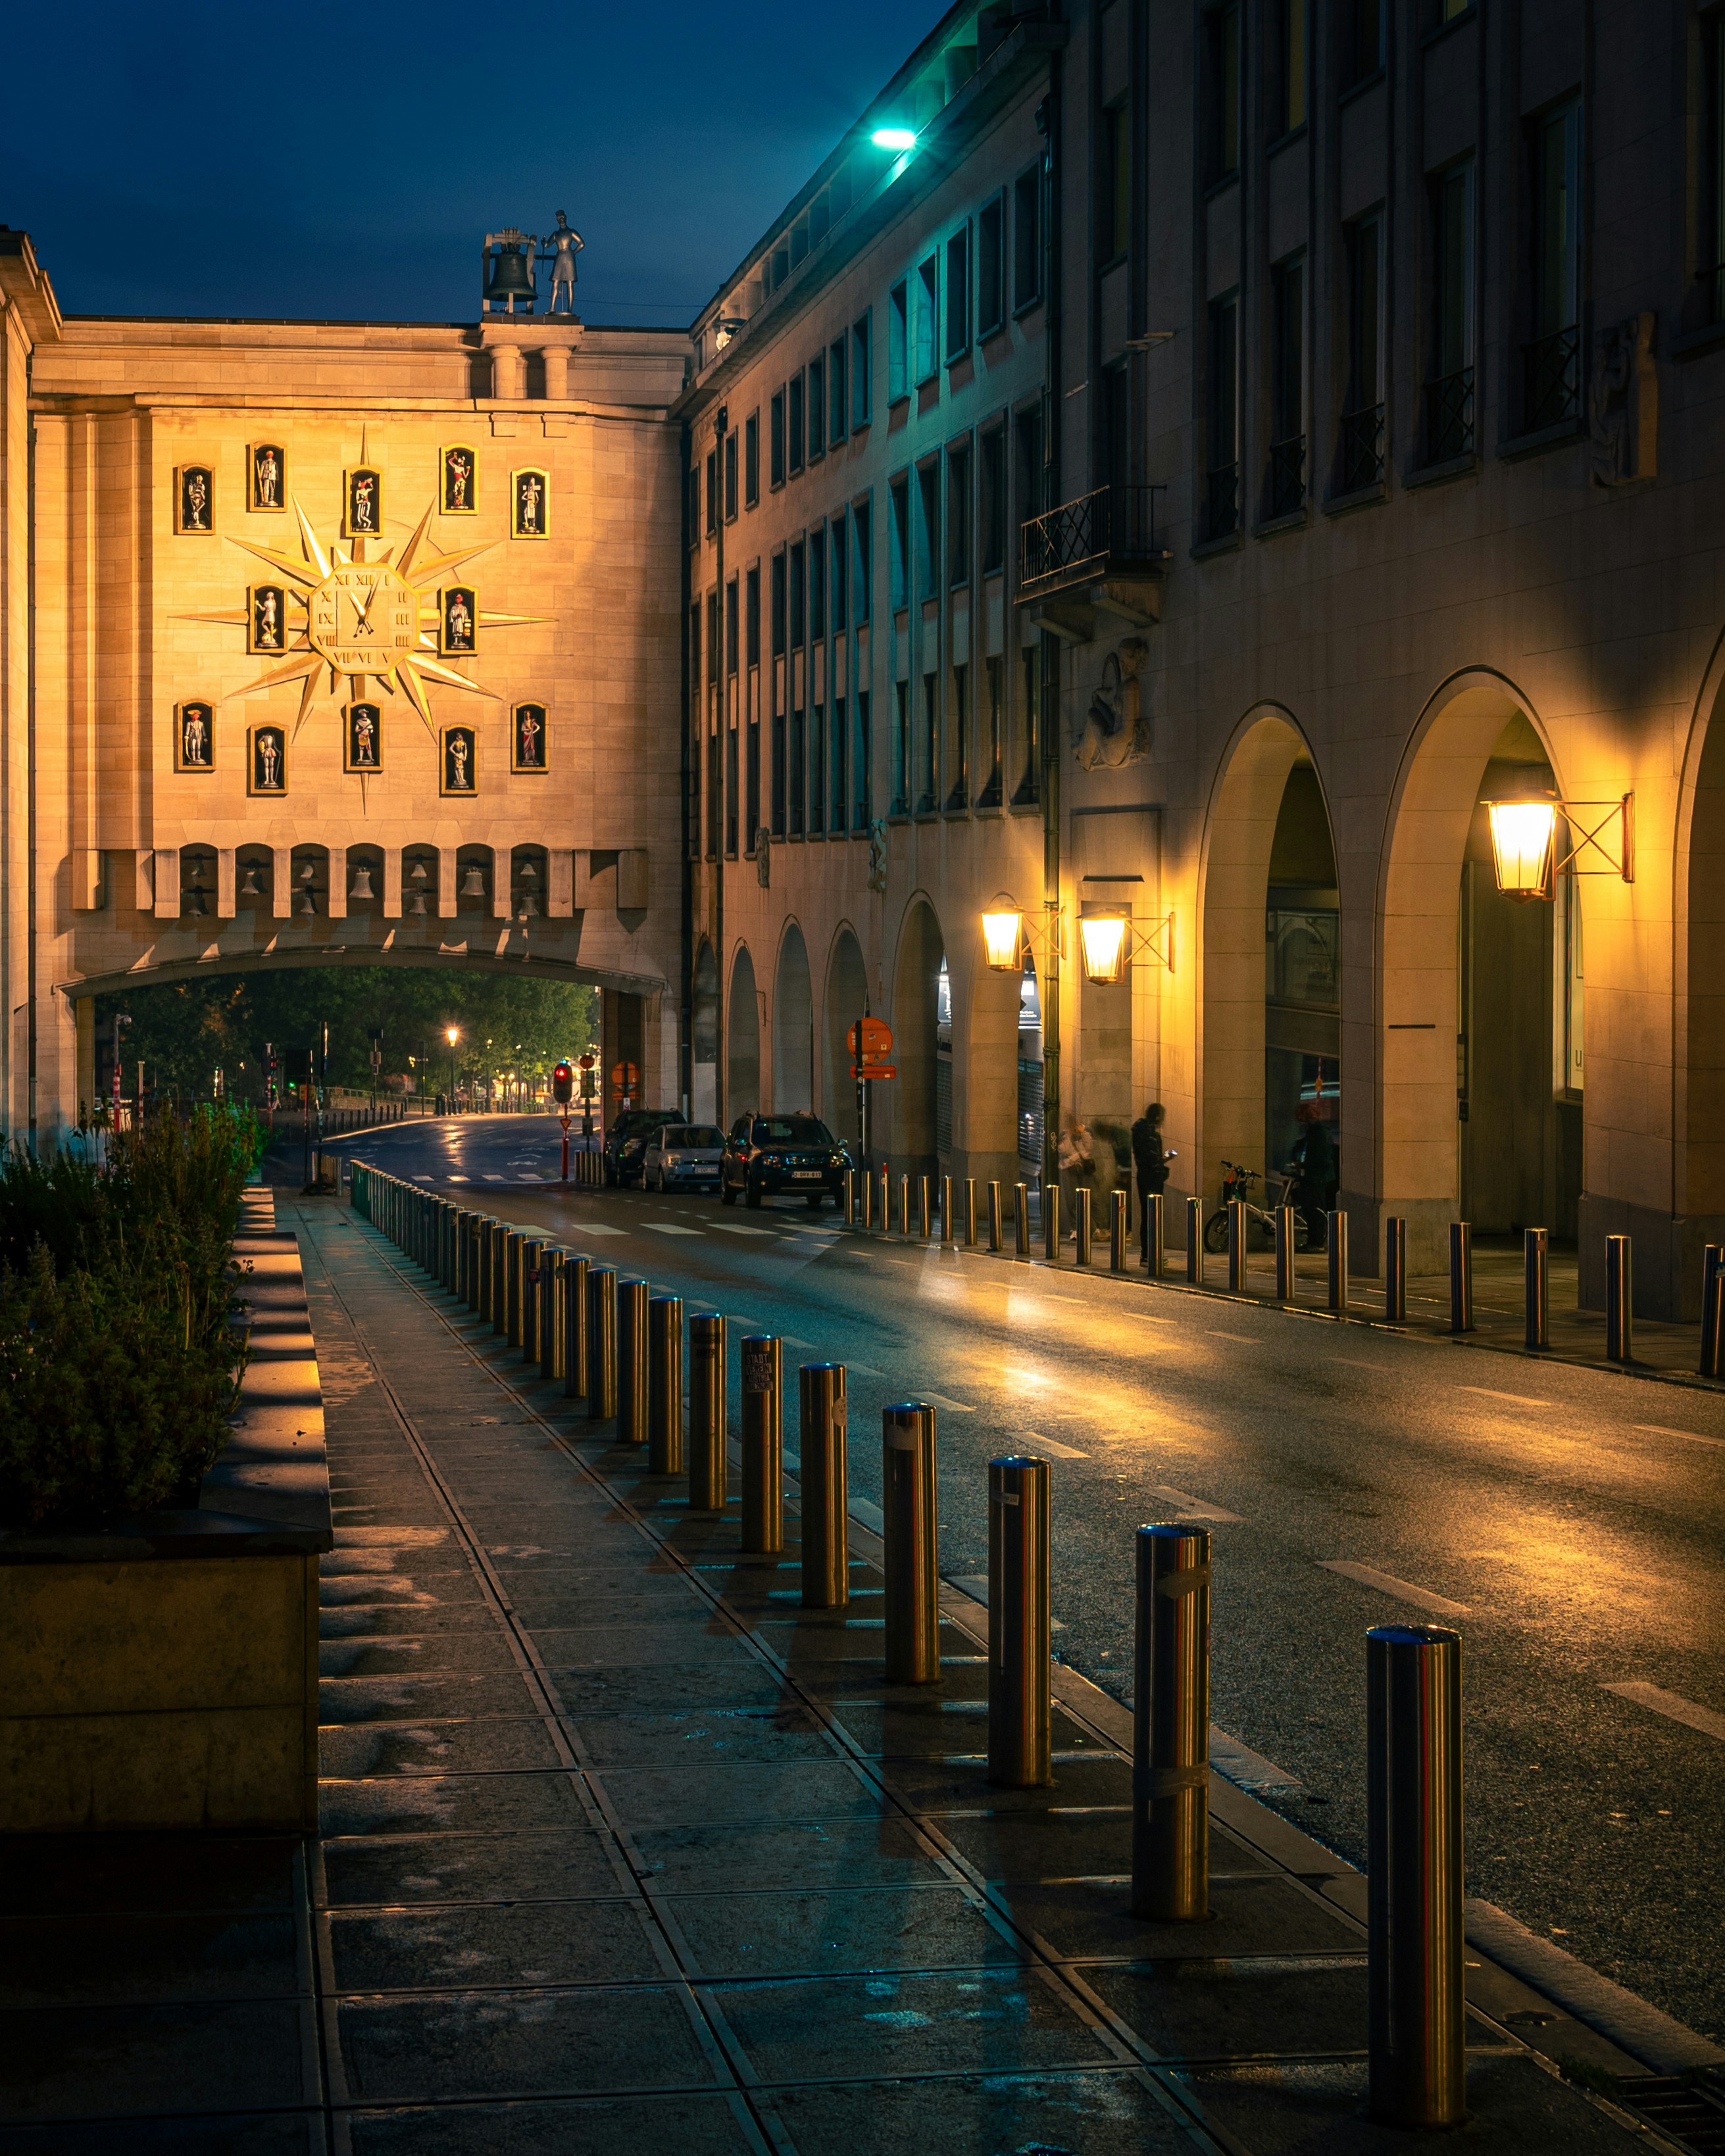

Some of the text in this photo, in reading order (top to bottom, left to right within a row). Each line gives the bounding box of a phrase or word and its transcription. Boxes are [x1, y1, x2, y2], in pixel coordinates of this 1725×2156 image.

[335, 574, 349, 585] XI
[356, 574, 373, 586] XII
[385, 574, 389, 586] I
[321, 591, 331, 602] X
[398, 592, 407, 603] II
[318, 613, 334, 624] IX
[396, 614, 409, 625] III
[316, 635, 336, 647] VIII
[395, 635, 410, 647] IIII
[334, 652, 351, 664] VII
[358, 652, 371, 664] VI
[382, 652, 391, 664] V
[746, 1353, 768, 1365] STADT
[747, 1364, 770, 1375] VEREIN
[747, 1373, 770, 1384] USTRIA
